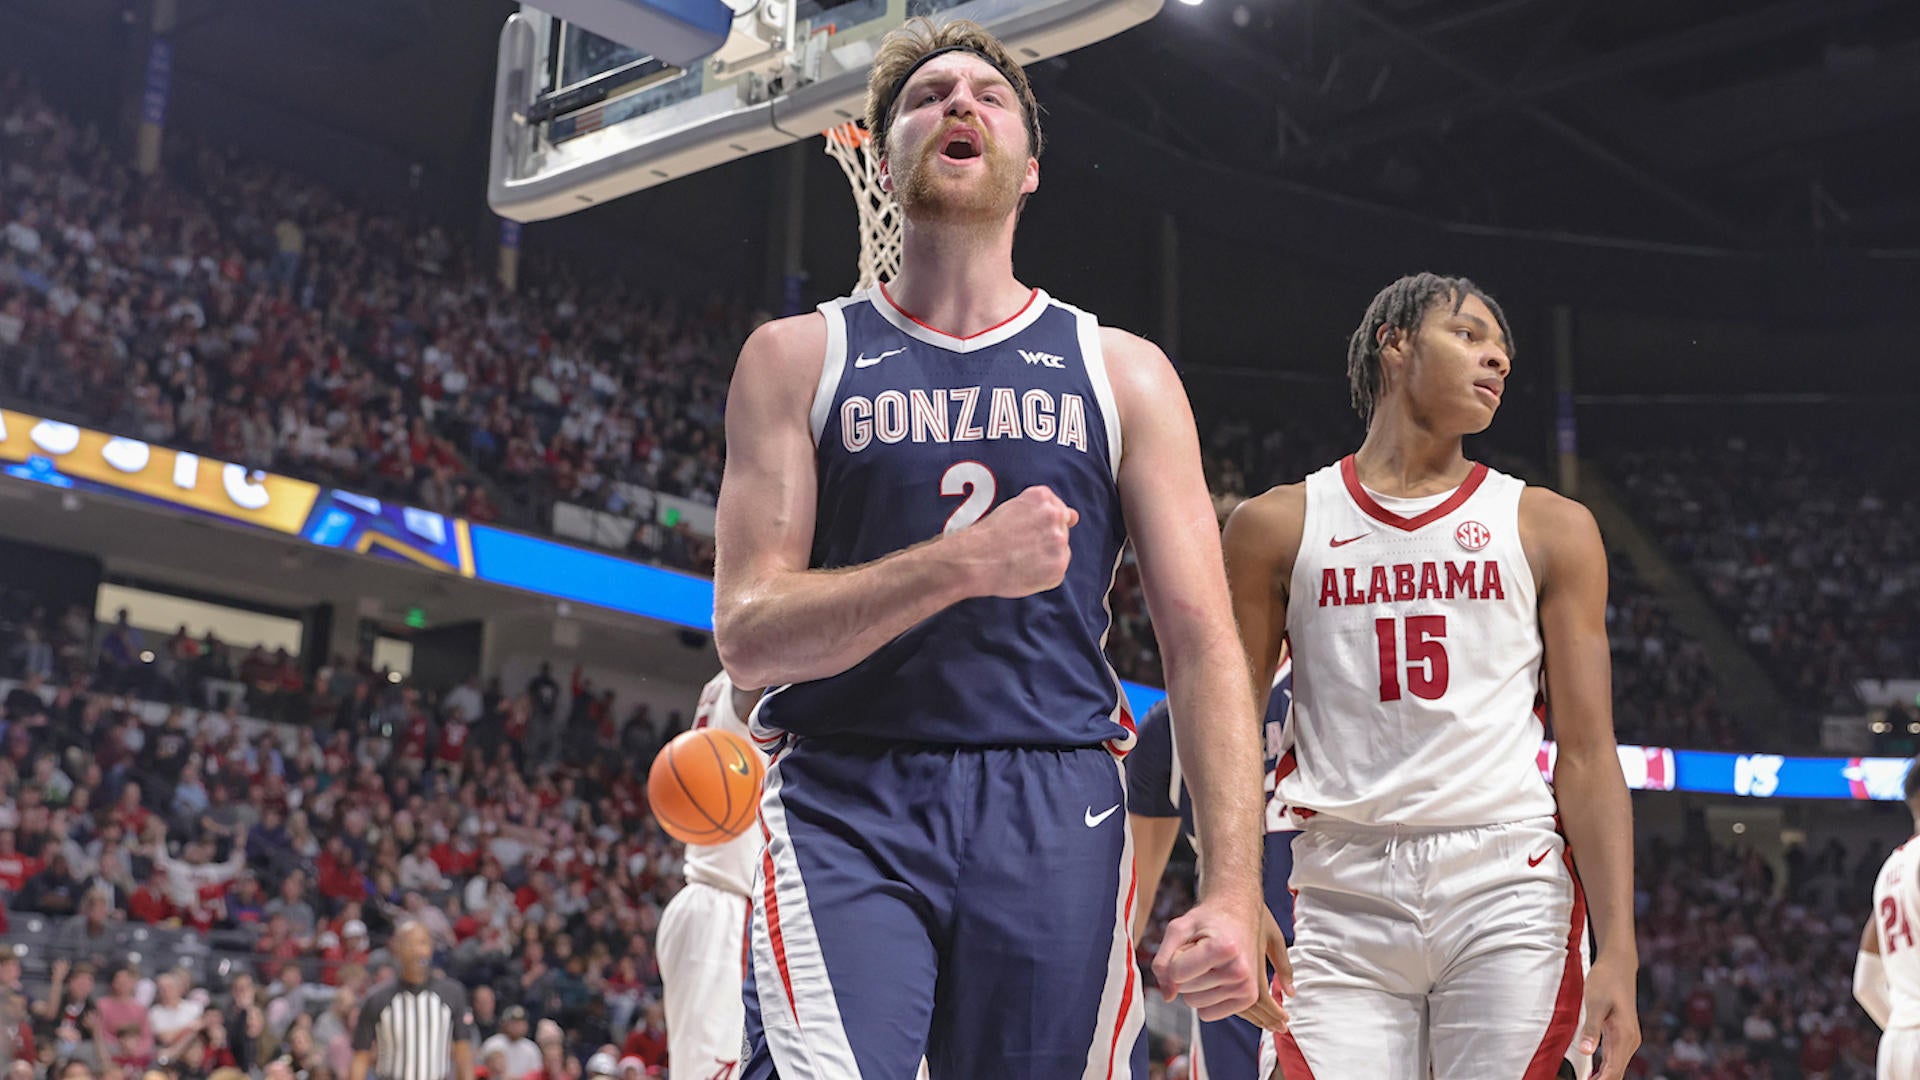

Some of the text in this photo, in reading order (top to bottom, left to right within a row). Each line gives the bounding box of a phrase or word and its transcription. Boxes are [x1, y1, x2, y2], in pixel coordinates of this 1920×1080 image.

[840, 386, 1088, 452] GONZAGA
[939, 459, 998, 537] 2
[1458, 521, 1491, 549] SEC
[1319, 560, 1505, 608] ALABAMA
[1375, 615, 1450, 702] 15
[1880, 895, 1914, 955] 24
